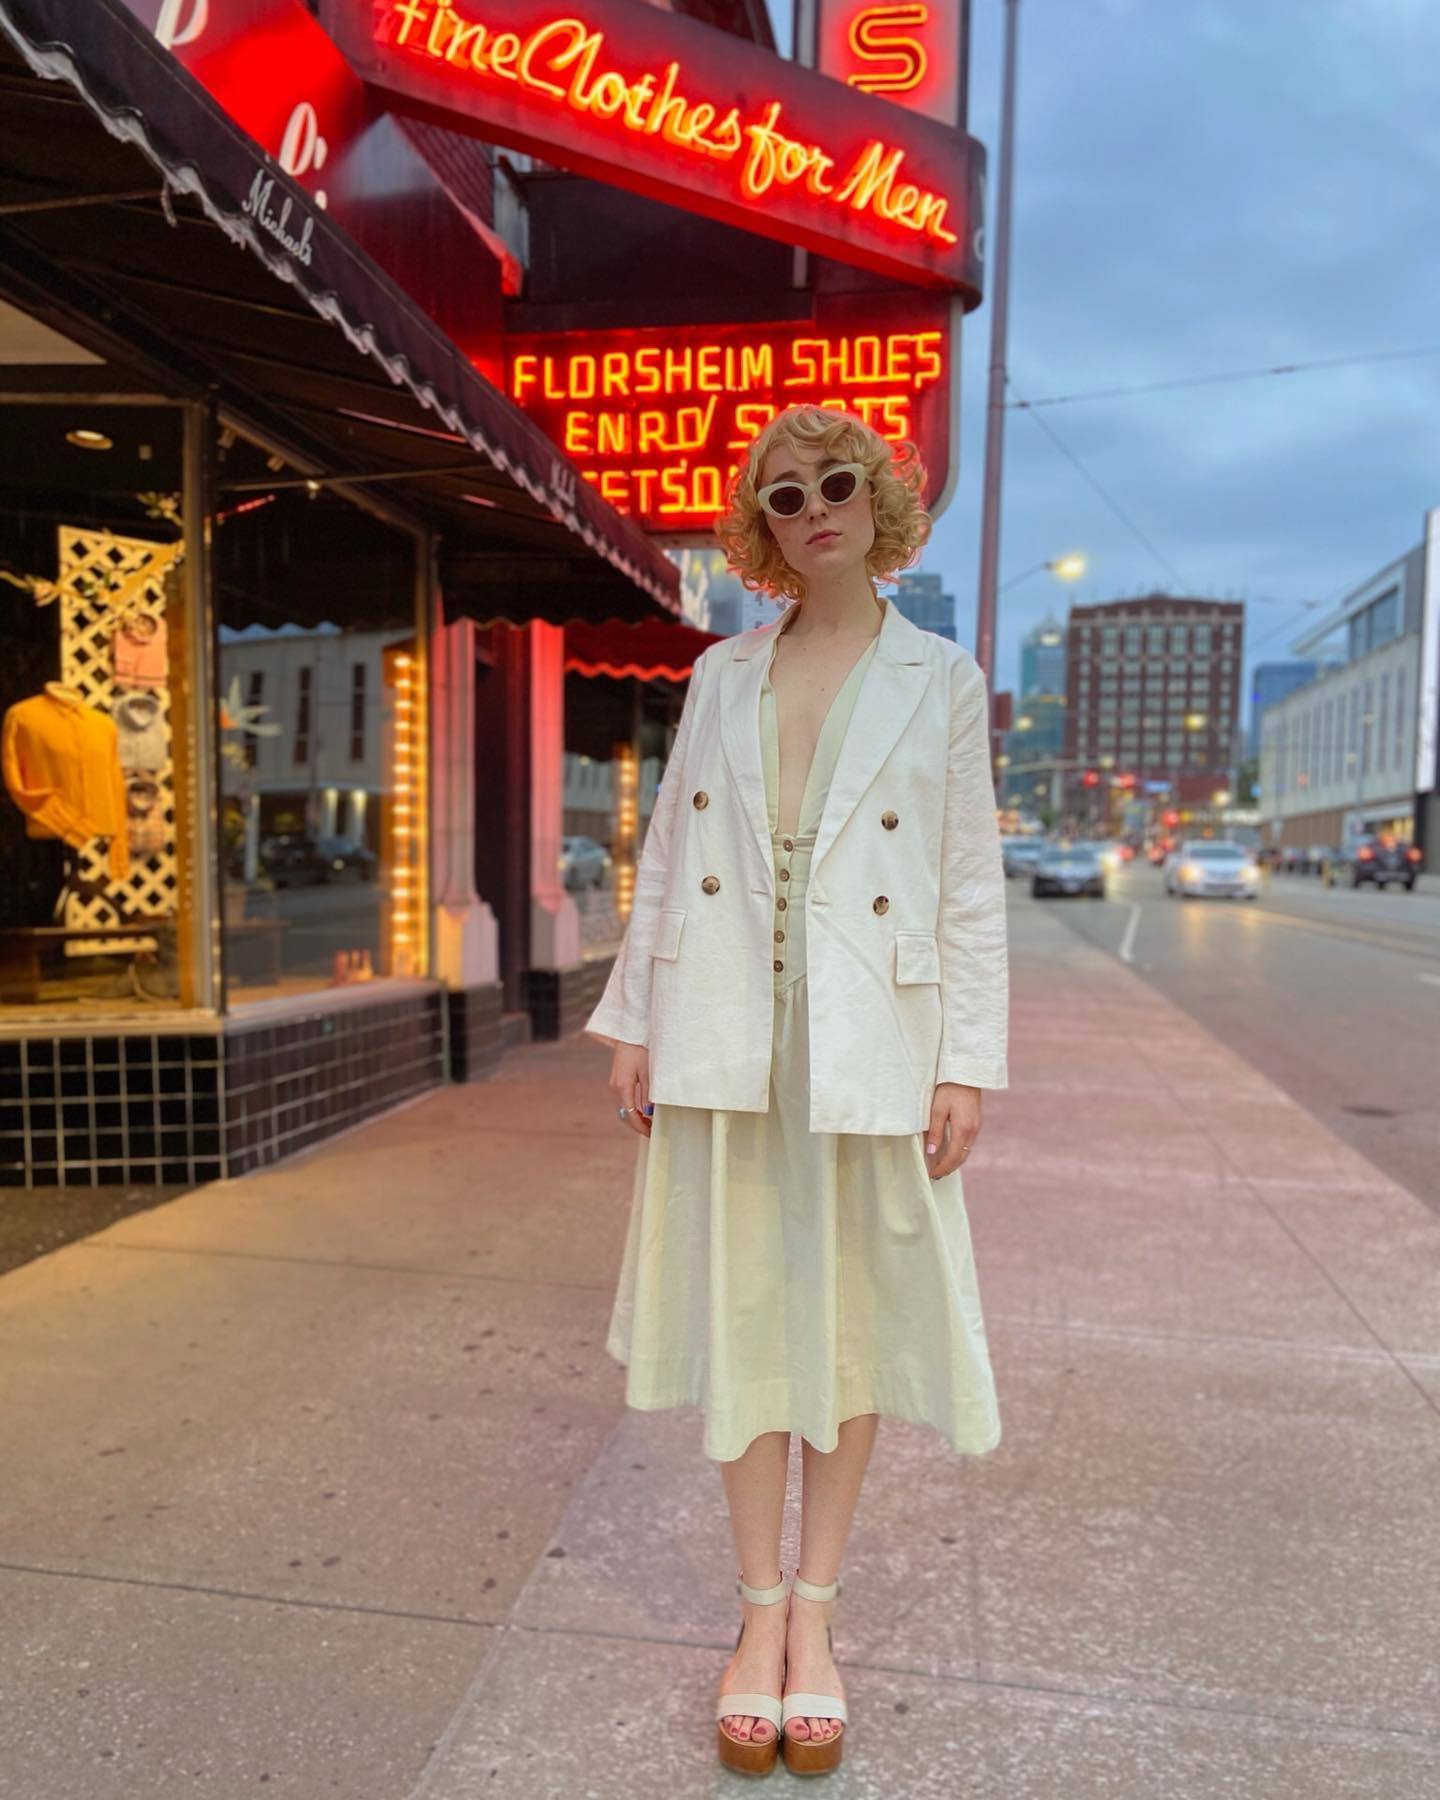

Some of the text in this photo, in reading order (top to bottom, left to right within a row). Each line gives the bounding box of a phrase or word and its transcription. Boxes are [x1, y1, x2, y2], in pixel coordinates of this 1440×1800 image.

[519, 18, 741, 153] Clothes
[748, 102, 835, 194] for
[836, 142, 958, 244] Men
[513, 331, 942, 399] FLORSHEIM SHOES
